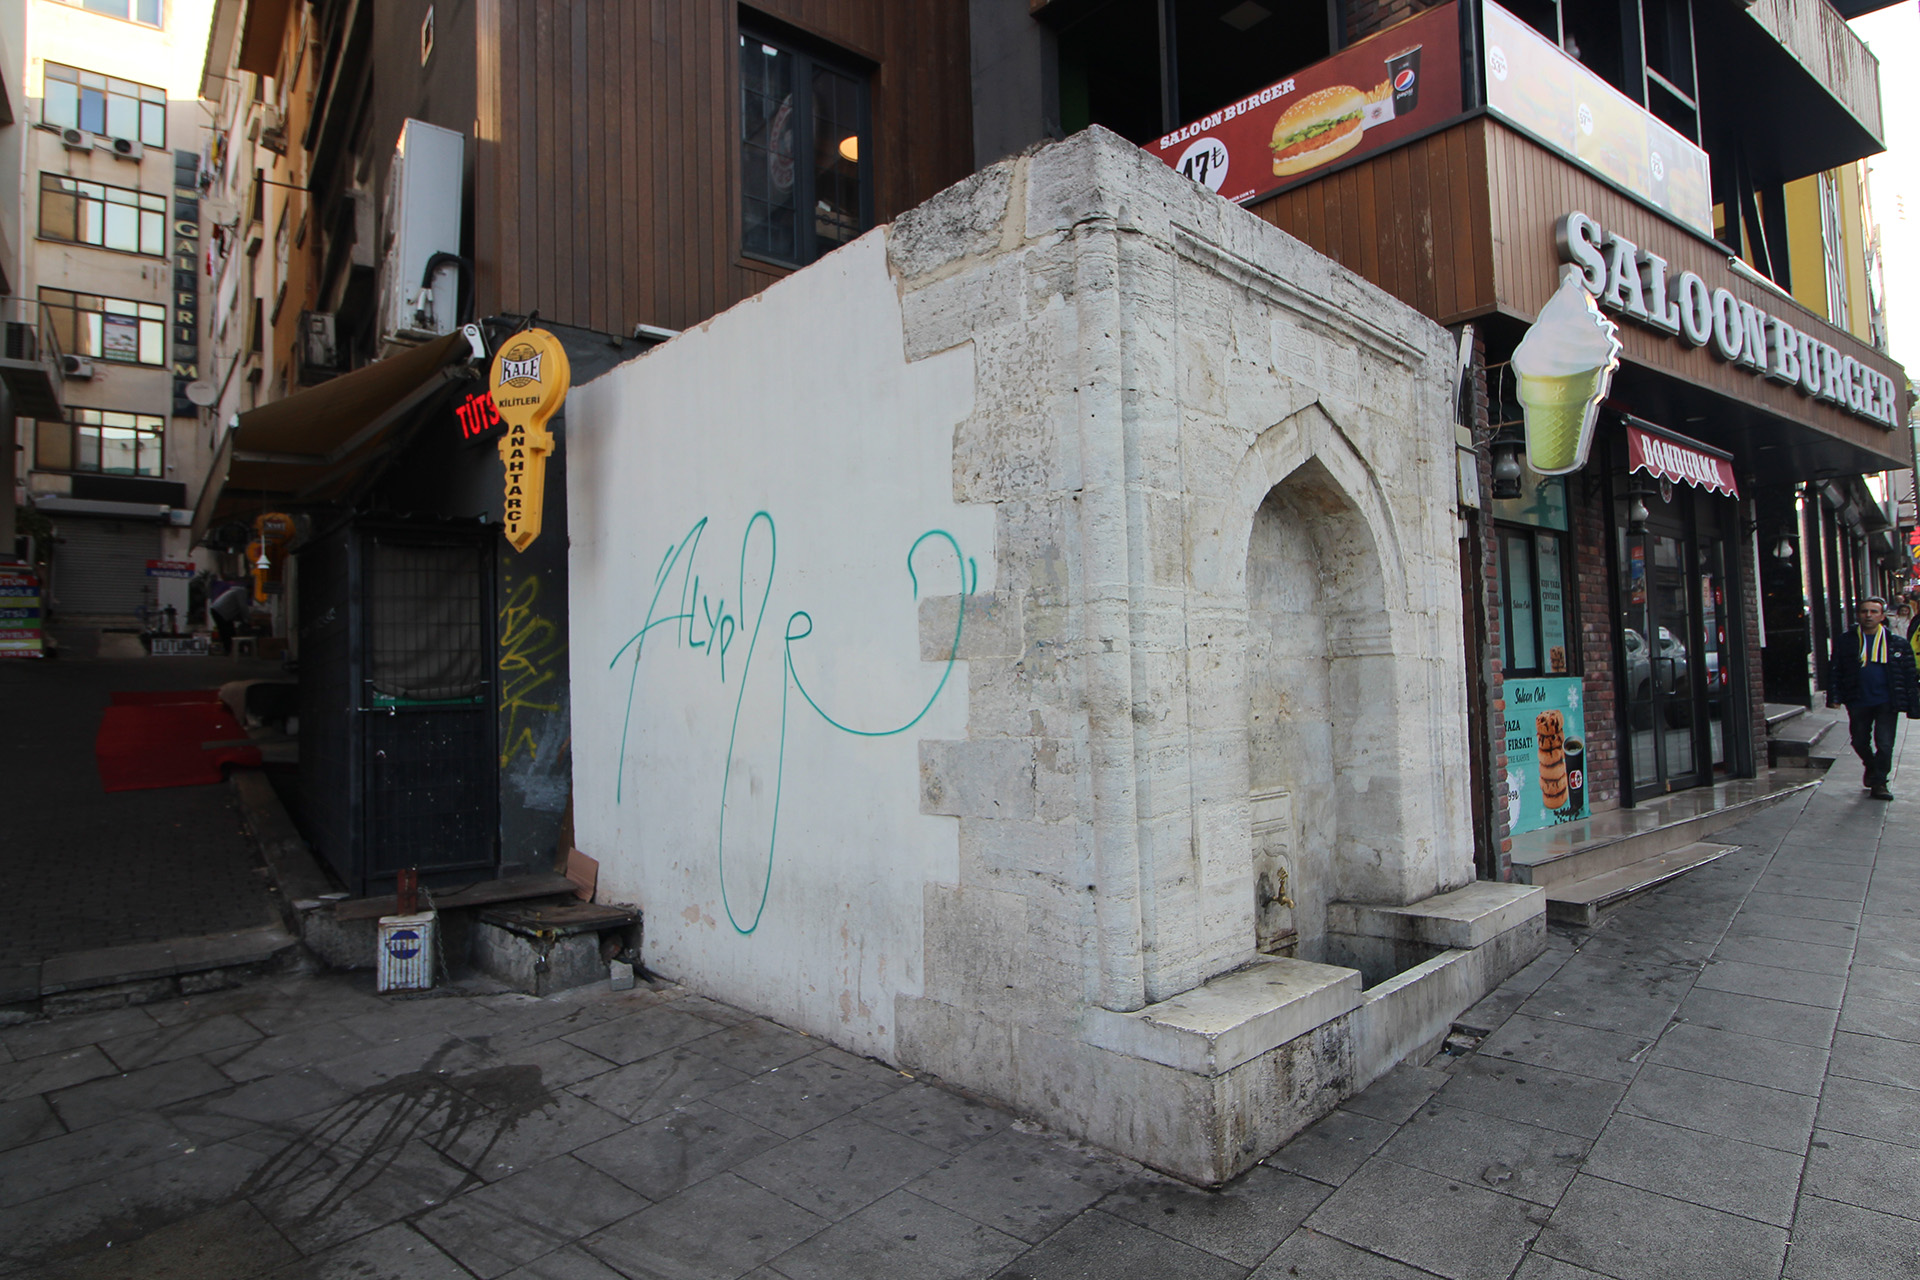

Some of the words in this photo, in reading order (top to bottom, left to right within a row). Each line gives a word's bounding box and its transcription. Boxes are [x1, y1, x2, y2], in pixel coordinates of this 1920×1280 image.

[1160, 111, 1223, 150] SALOON
[1223, 78, 1296, 121] BURGER
[1558, 210, 1768, 374] SALOON
[1767, 316, 1899, 430] BURGER
[503, 357, 539, 381] KALE
[499, 395, 540, 408] KİLİTLERİ
[507, 424, 525, 533] ANAHTARCI
[1641, 434, 1725, 486] DONDURMA
[1508, 737, 1533, 751] FIRSAT!
